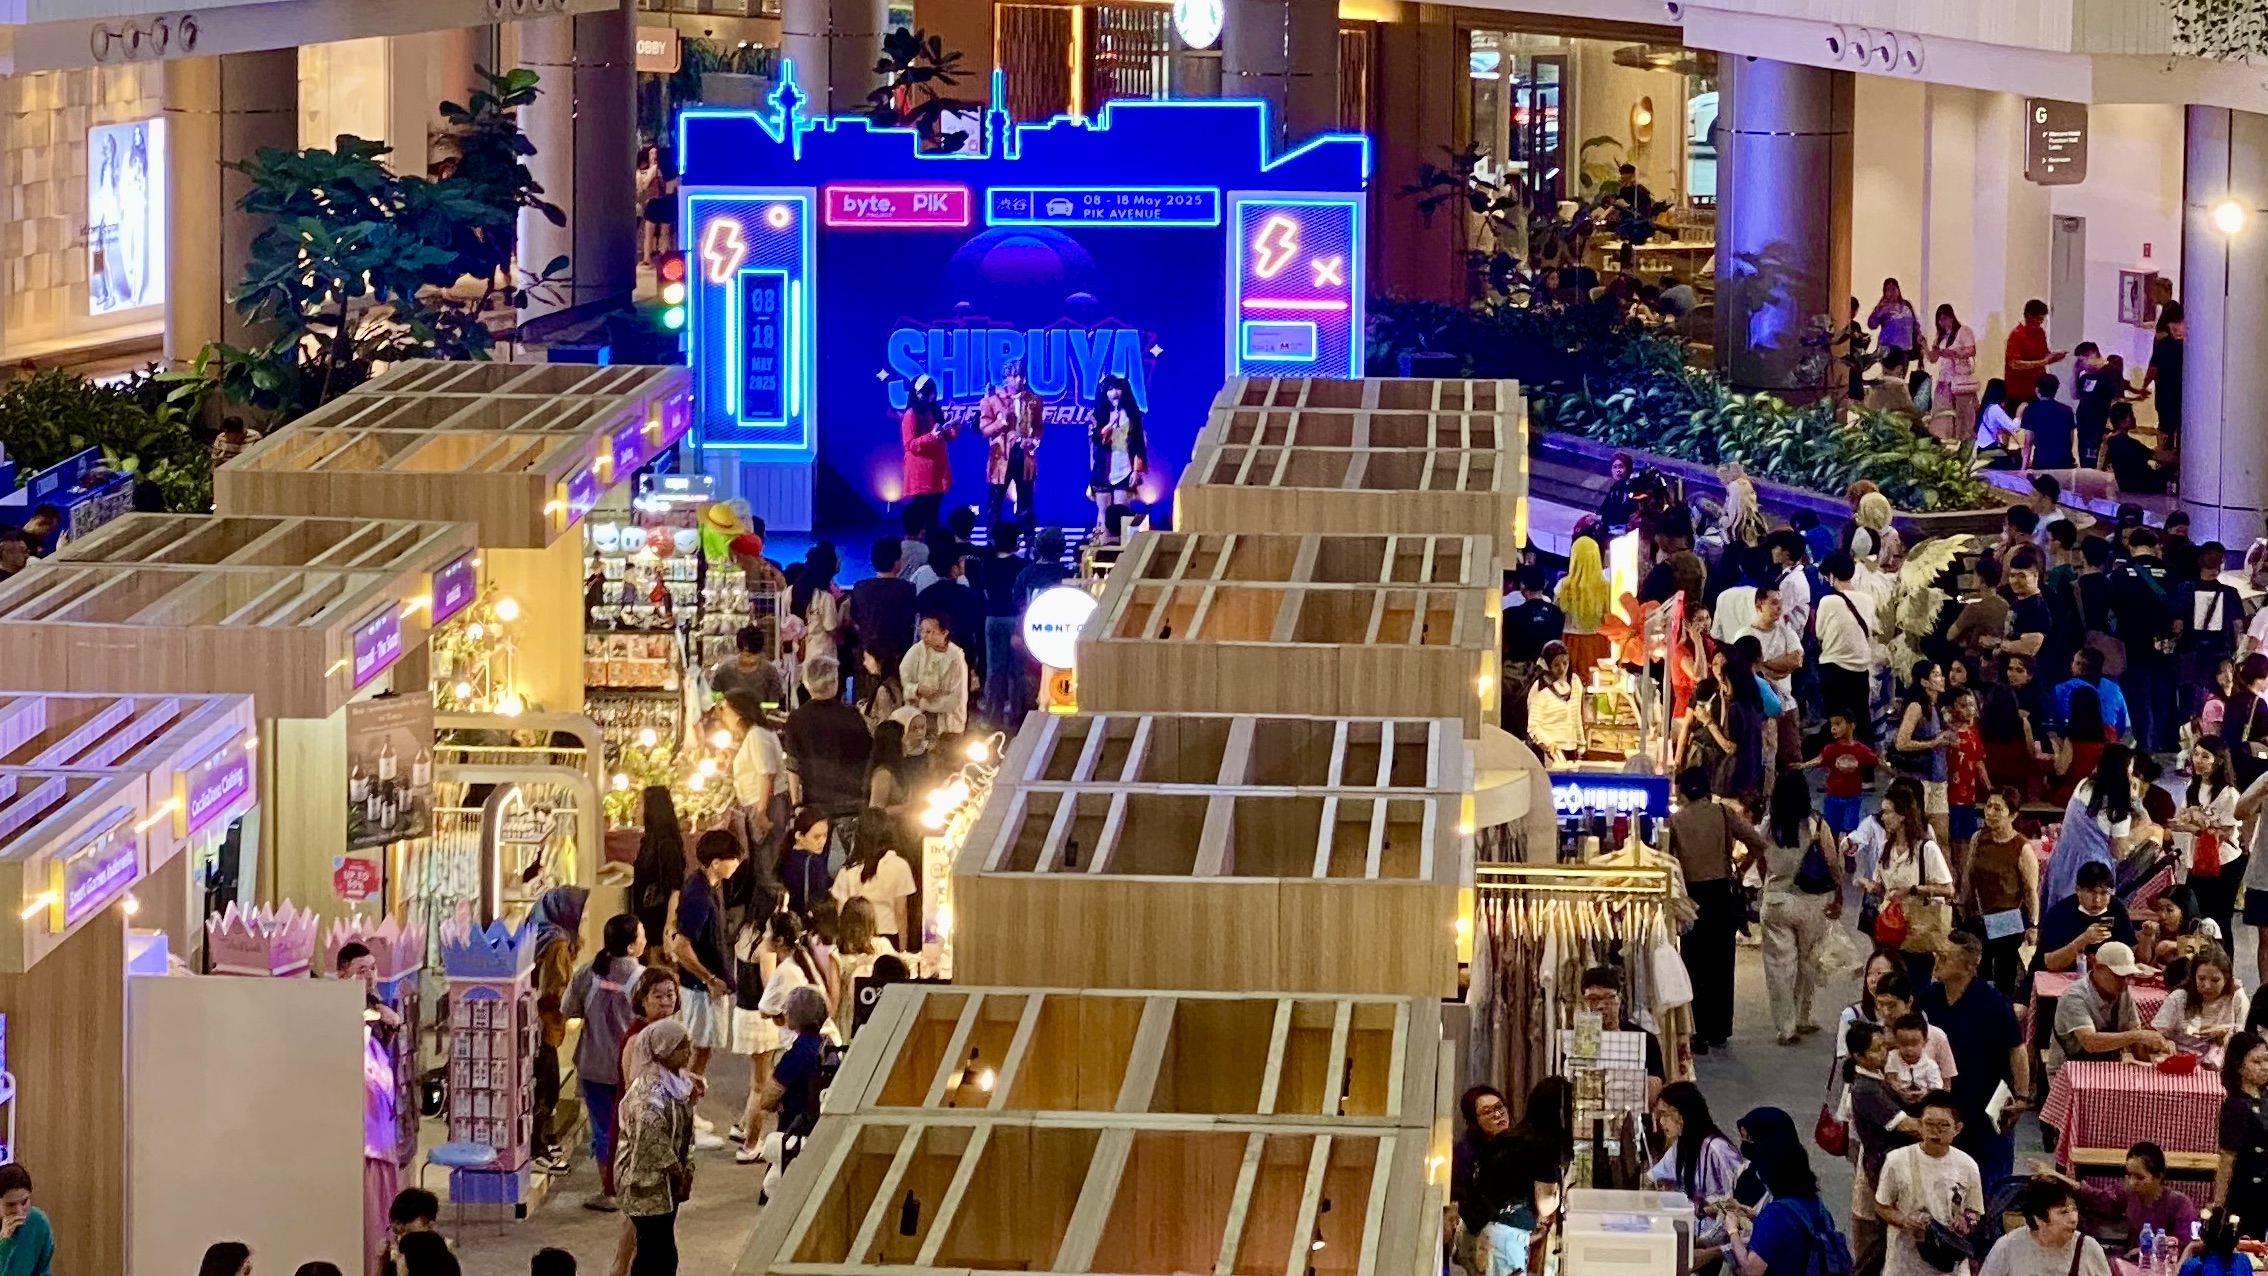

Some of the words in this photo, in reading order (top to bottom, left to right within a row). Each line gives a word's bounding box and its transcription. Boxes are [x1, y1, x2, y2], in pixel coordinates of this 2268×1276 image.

[636, 40, 666, 55] OBBY
[2035, 107, 2048, 124] G
[843, 194, 896, 217] byte.
[913, 193, 948, 212] PIK
[1084, 195, 1101, 205] 08
[1117, 195, 1129, 205] 18
[1134, 195, 1161, 207] May
[1166, 195, 1202, 206] 2025
[1084, 209, 1104, 218] PIK
[1110, 209, 1161, 219] AVENUE
[752, 288, 775, 313] 08
[752, 325, 774, 348] 18
[752, 357, 773, 371] MAY
[750, 375, 776, 390] 2025
